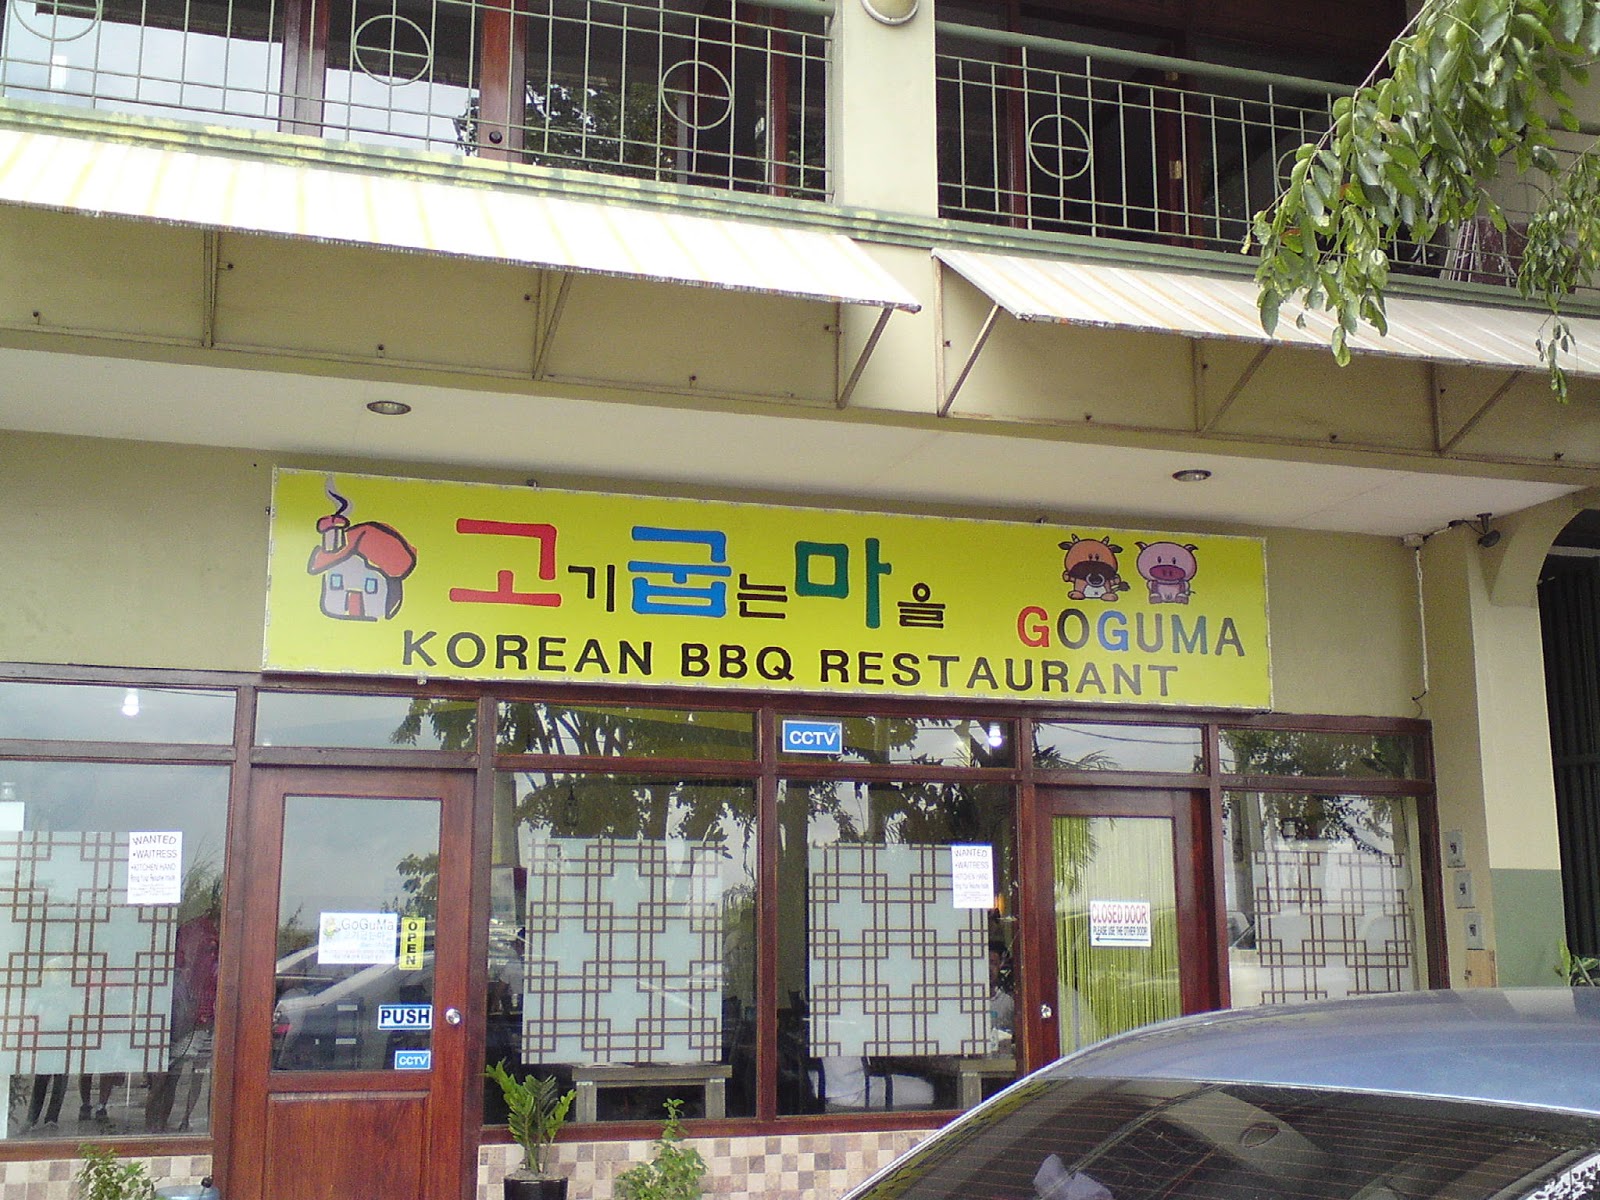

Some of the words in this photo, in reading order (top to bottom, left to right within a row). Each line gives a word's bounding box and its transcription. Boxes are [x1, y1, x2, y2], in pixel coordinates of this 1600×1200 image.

[1016, 605, 1246, 657] GOGUMA
[402, 629, 653, 676] KOREAN
[680, 642, 795, 682] BBQ
[819, 648, 1179, 697] RESTAURANT
[789, 730, 837, 746] CCTV
[132, 834, 177, 846] WANTED
[954, 848, 988, 858] WANTED
[1092, 904, 1123, 924] CLOSED
[1124, 905, 1148, 924] DOOR
[341, 918, 395, 931] GoGuMa
[405, 921, 419, 966] OPEN
[380, 1009, 430, 1024] PUSH
[399, 1056, 428, 1066] CCTV
